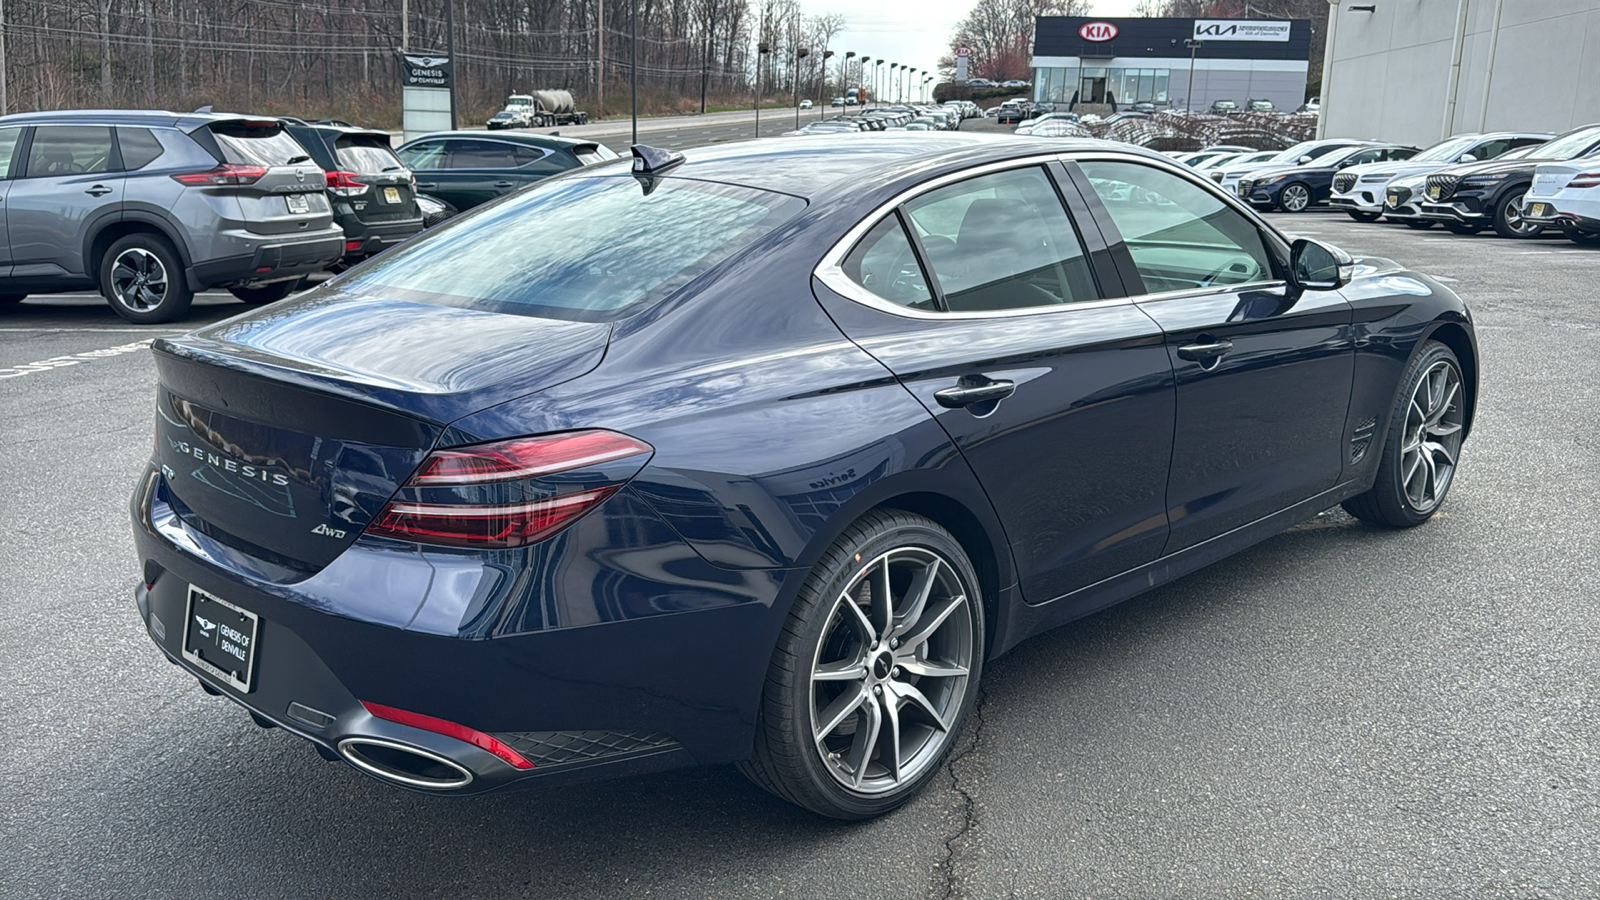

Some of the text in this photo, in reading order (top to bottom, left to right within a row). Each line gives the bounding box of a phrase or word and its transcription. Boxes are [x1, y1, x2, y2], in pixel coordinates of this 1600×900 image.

[1086, 26, 1111, 38] KIA
[1196, 24, 1237, 36] KIA
[411, 69, 443, 77] GENESIS
[180, 442, 290, 486] GENESIS
[311, 523, 347, 539] AWD
[220, 623, 242, 643] GENESIS
[241, 635, 250, 647] OF
[221, 639, 247, 661] DENVILLE
